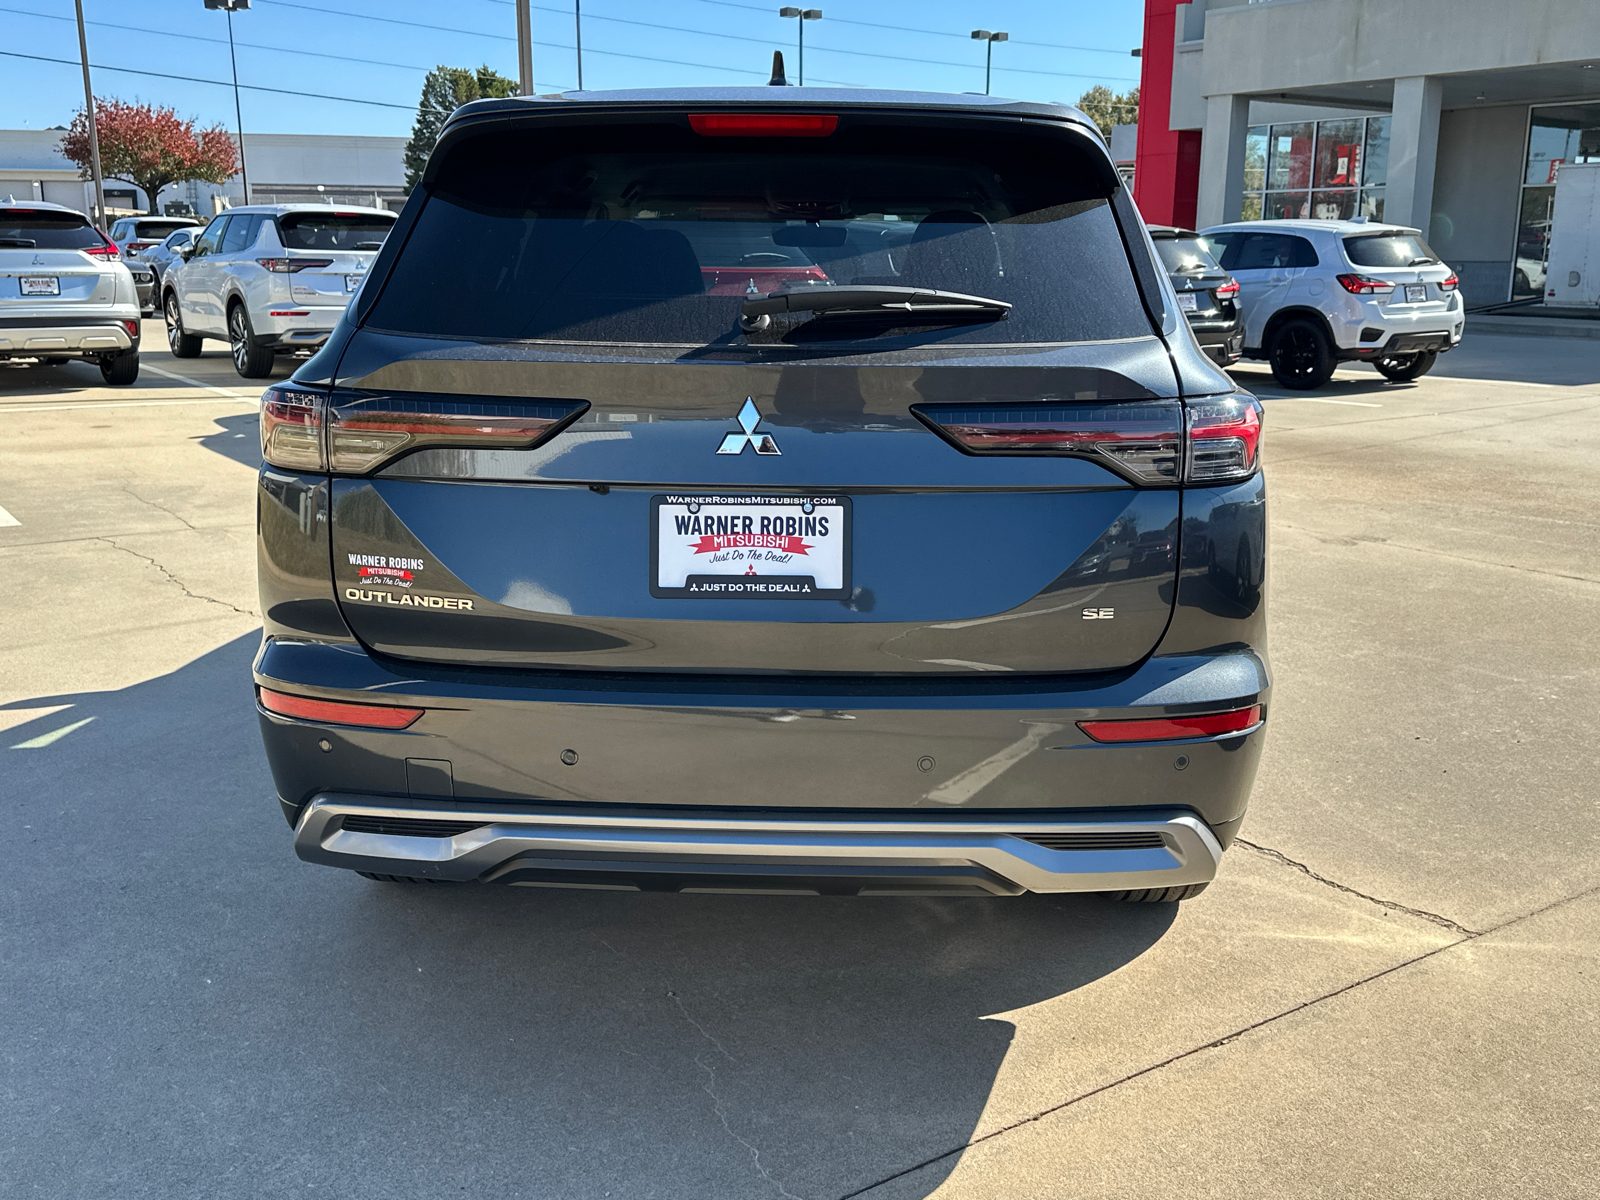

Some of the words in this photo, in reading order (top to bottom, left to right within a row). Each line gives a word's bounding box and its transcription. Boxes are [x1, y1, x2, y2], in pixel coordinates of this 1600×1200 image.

[675, 515, 753, 535] WARNER
[760, 516, 829, 537] ROBINS
[713, 535, 789, 549] MITSUBISHI
[348, 553, 387, 567] WARNER
[388, 556, 424, 570] ROBINS
[709, 551, 730, 564] Just
[731, 550, 745, 560] Do
[748, 549, 763, 561] The
[765, 551, 793, 564] Deal!
[367, 567, 405, 577] MITSUBISHI
[359, 577, 373, 585] Just
[373, 576, 381, 584] Do
[382, 577, 393, 586] The
[394, 578, 413, 589] Deal!
[700, 583, 727, 592] JUST
[728, 583, 744, 592] DO
[745, 583, 767, 592] THE
[768, 584, 800, 593] DEAL!
[345, 588, 475, 611] OUTLANDER
[1082, 607, 1115, 620] SE
